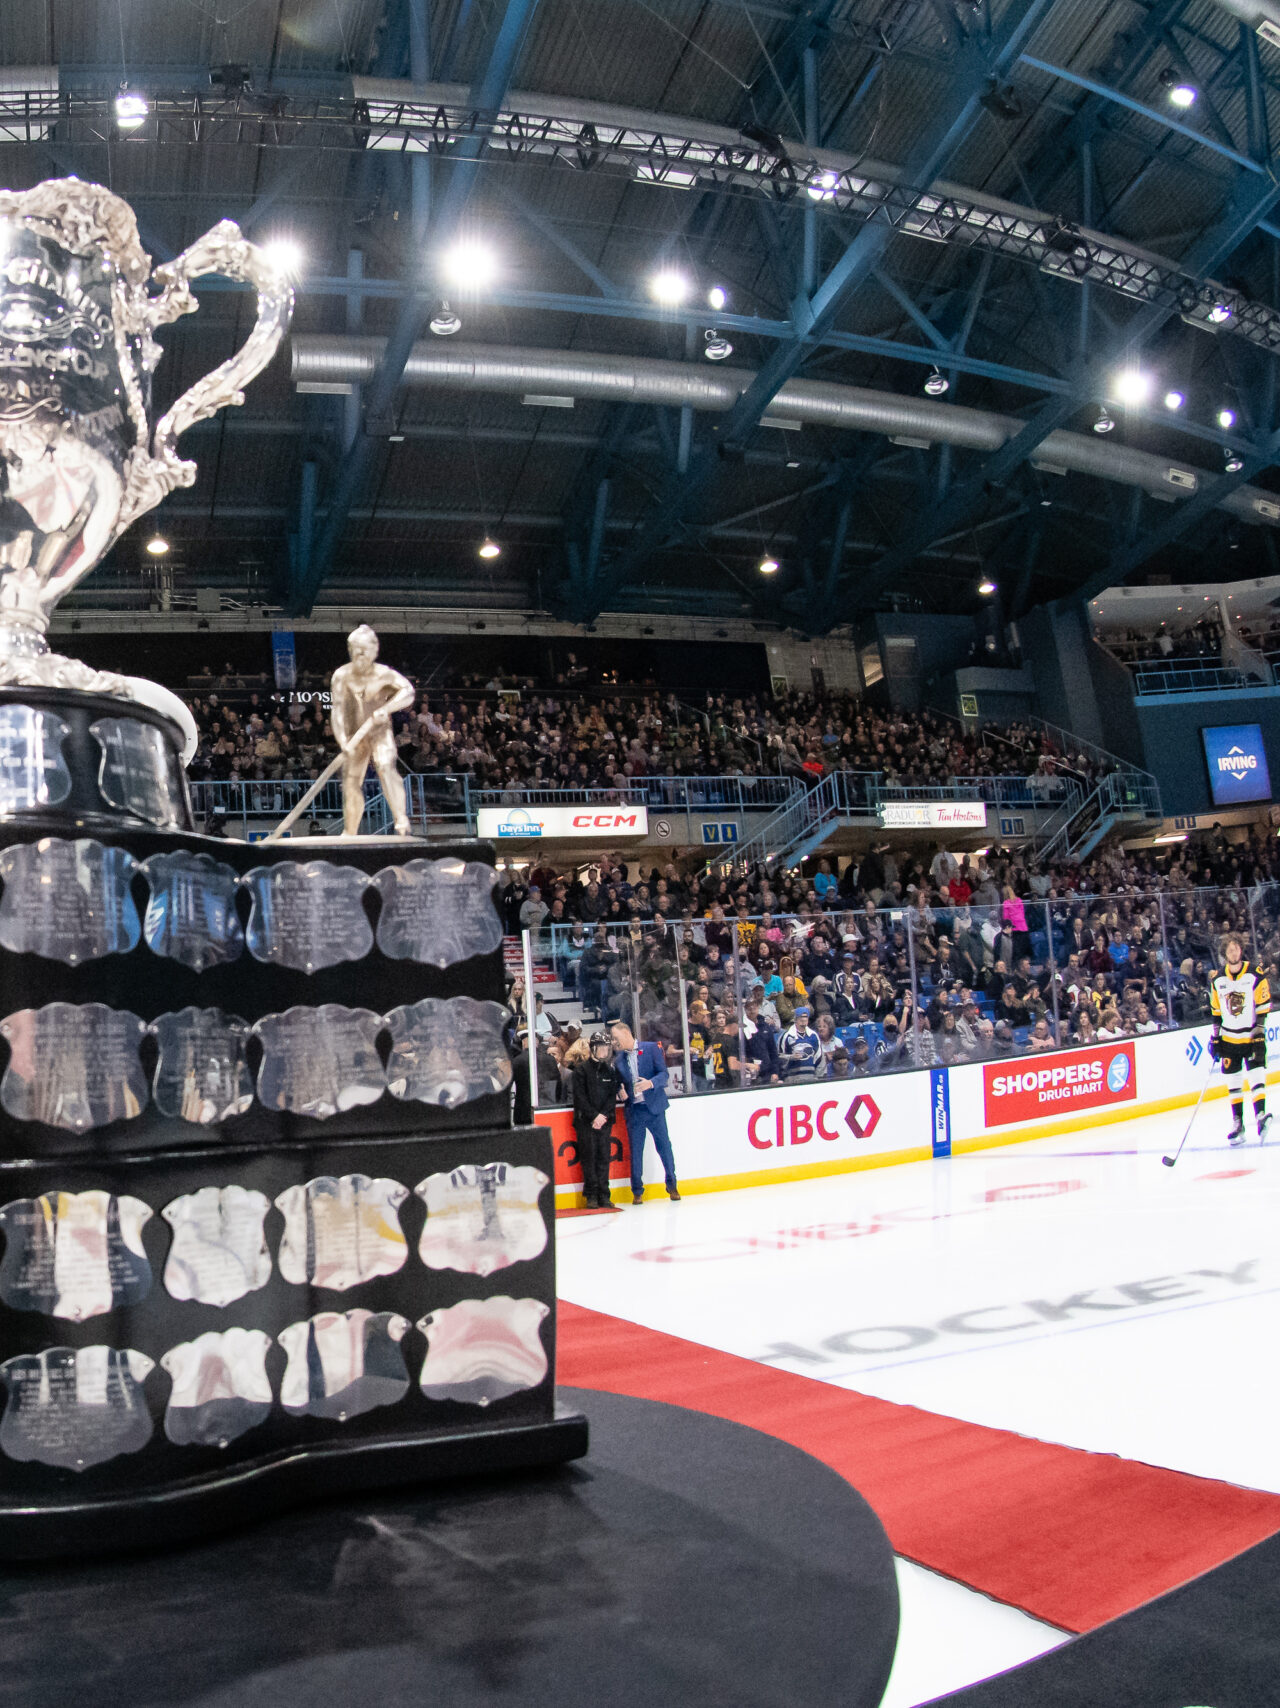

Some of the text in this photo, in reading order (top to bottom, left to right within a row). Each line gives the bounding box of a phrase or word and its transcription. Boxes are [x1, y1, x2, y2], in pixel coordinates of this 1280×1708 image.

[1217, 755, 1257, 771] IRVING
[572, 815, 637, 828] CCM
[992, 1061, 1103, 1097] SHOPPERS
[1038, 1080, 1104, 1103] DRUG MART
[747, 1100, 841, 1150] CIBC
